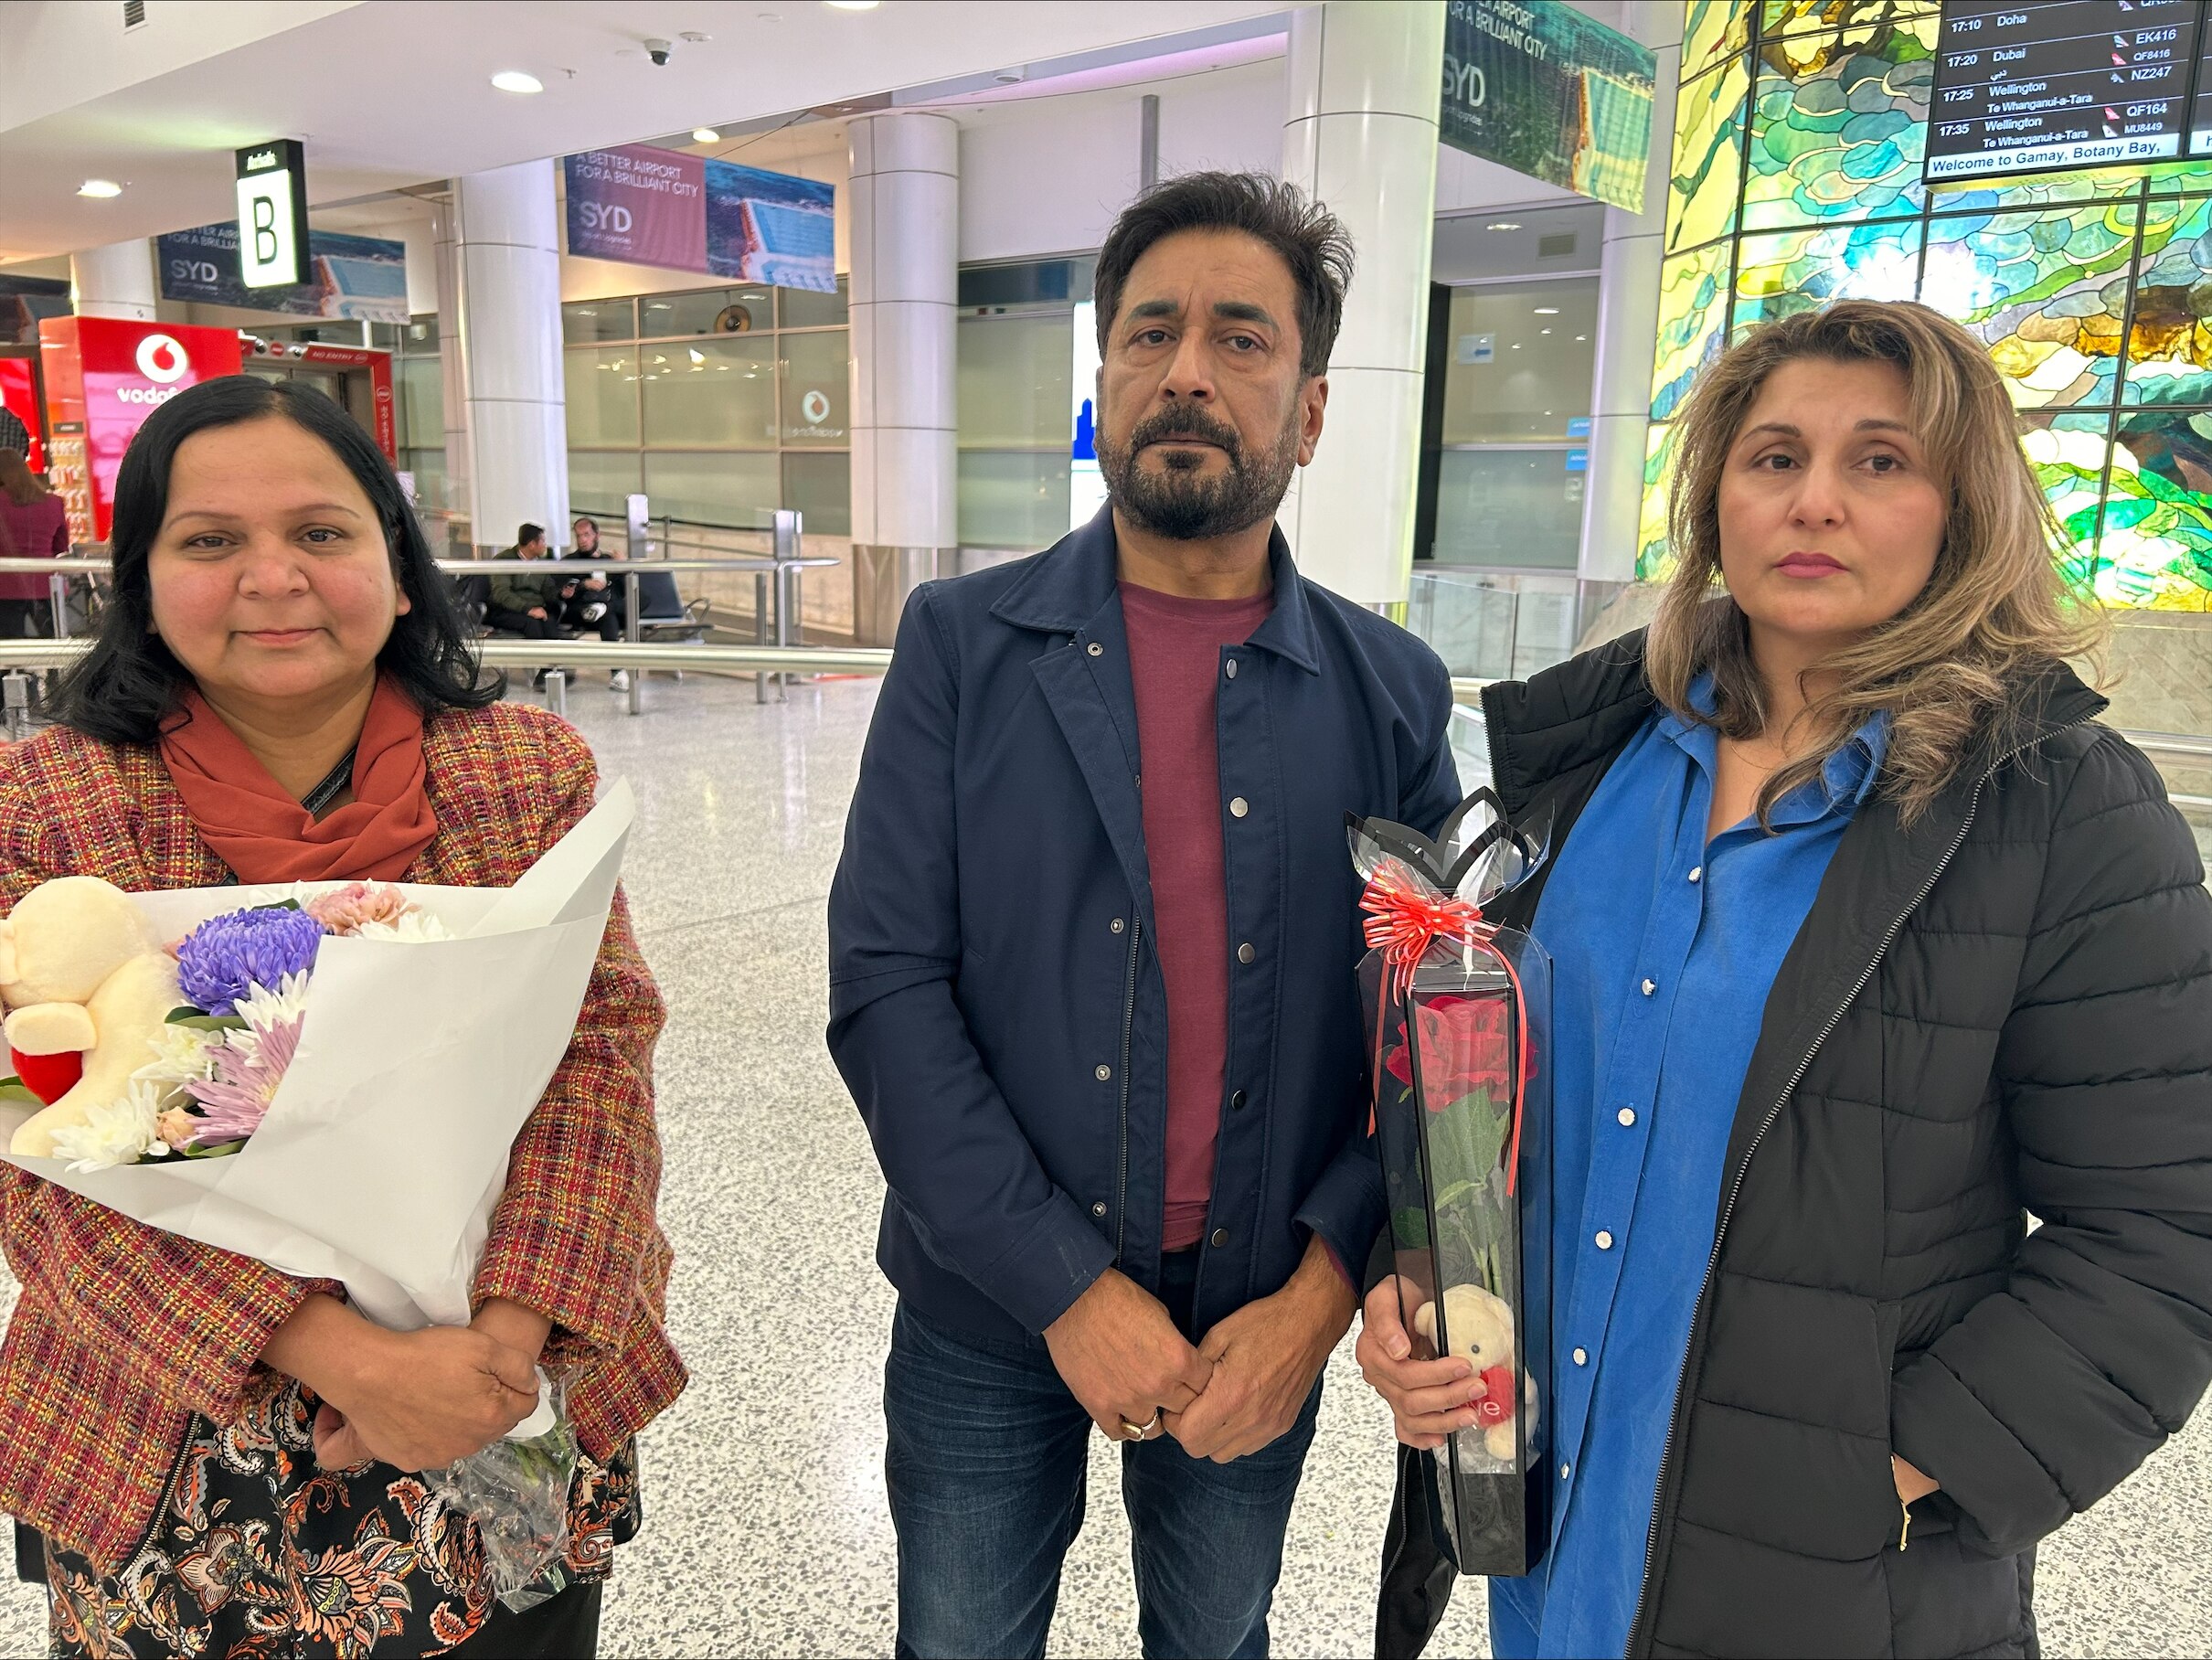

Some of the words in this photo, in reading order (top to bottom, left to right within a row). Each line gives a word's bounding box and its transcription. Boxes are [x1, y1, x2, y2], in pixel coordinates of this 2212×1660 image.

[1465, 5, 1473, 26] A
[1475, 10, 1524, 49] BRILLIANT
[1524, 36, 1548, 60] CITY
[1951, 19, 1982, 33] 17:10
[1997, 14, 2027, 27] Doha
[1948, 55, 1978, 67] 17:20
[1993, 48, 2026, 62] Dubai
[2135, 28, 2176, 45] EK416
[2133, 48, 2171, 61] QF8416
[1443, 53, 1485, 107] SYD
[1943, 89, 1974, 101] 17:25
[1989, 81, 2047, 97] Wellington
[2131, 66, 2172, 80] NZ247
[1987, 103, 2000, 113] Te
[2003, 94, 2093, 112] Whanganui-a-Tara
[1940, 123, 1970, 136] 17:35
[1984, 117, 2043, 132] Wellington
[2127, 102, 2167, 117] QF164
[2124, 122, 2163, 134] MU8449
[1983, 138, 1996, 148] Te
[1998, 130, 2089, 146] Whanganui-a-Tara
[588, 152, 632, 171] BETTER
[634, 160, 682, 180] AIRPORT
[1933, 157, 1994, 172] Welcome
[1999, 155, 2011, 165] to
[2016, 151, 2068, 163] Gamay,
[2074, 145, 2123, 158] Botany
[2129, 142, 2160, 154] Bay,
[576, 164, 602, 180] FOR
[602, 169, 613, 182] A
[613, 171, 671, 192] BRILLIANT
[672, 182, 698, 197] CITY
[253, 196, 278, 266] B
[580, 201, 633, 232] SYD
[191, 234, 199, 245] A
[171, 260, 218, 282] SYD
